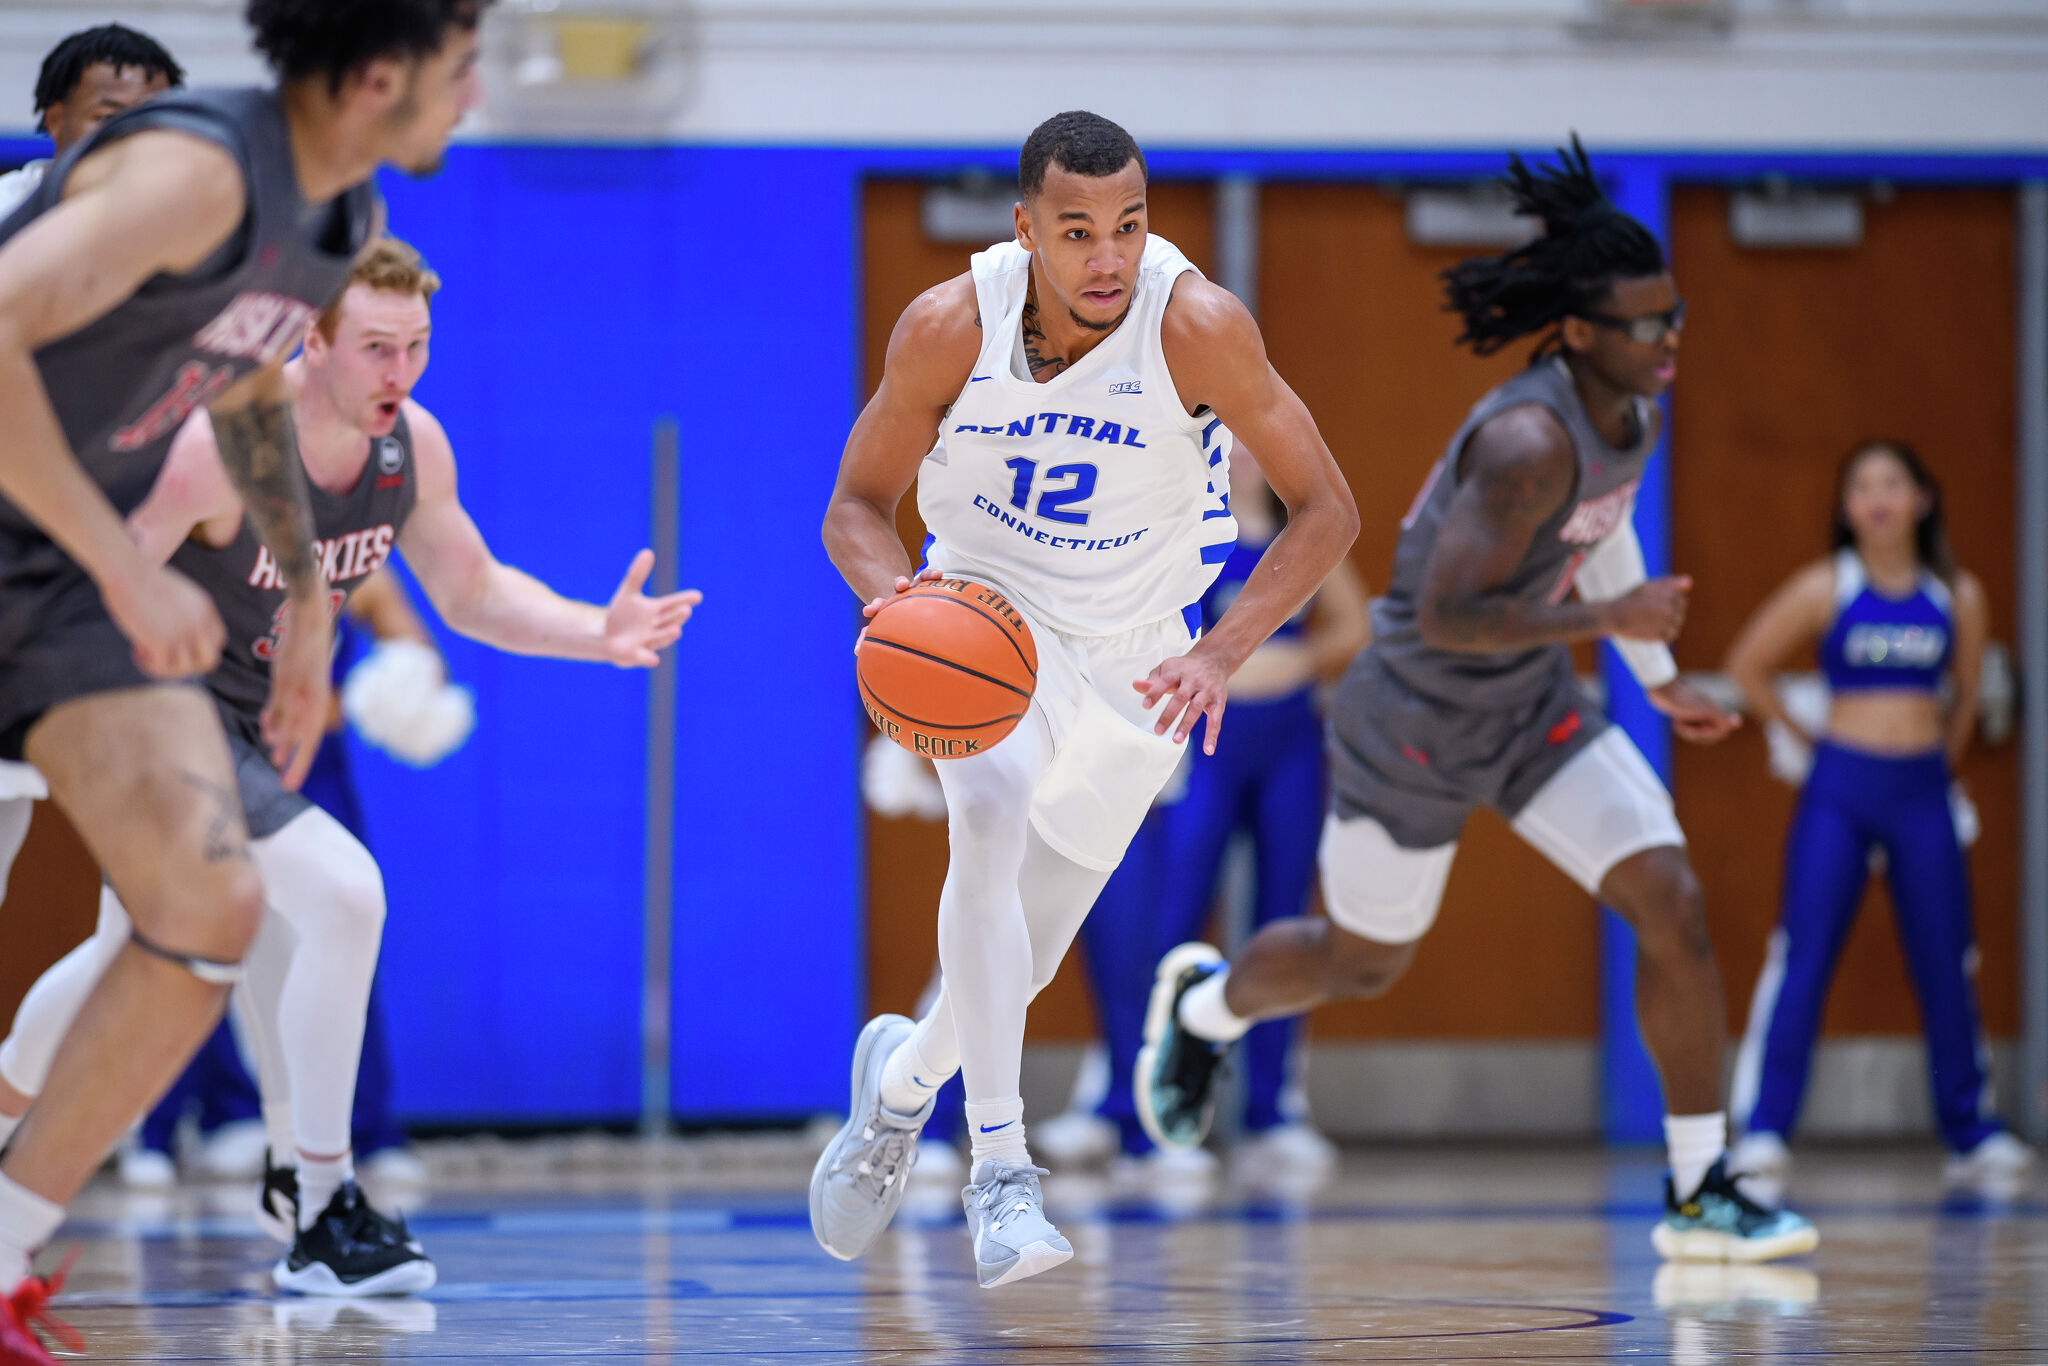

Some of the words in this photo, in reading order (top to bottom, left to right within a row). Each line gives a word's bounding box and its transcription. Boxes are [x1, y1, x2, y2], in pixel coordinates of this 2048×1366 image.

[1108, 380, 1142, 393] NEC
[1003, 454, 1100, 527] 12
[972, 494, 1150, 551] CONNECTICUT
[909, 578, 973, 592] RO
[977, 588, 1023, 633] THE
[911, 730, 982, 757] ROCK
